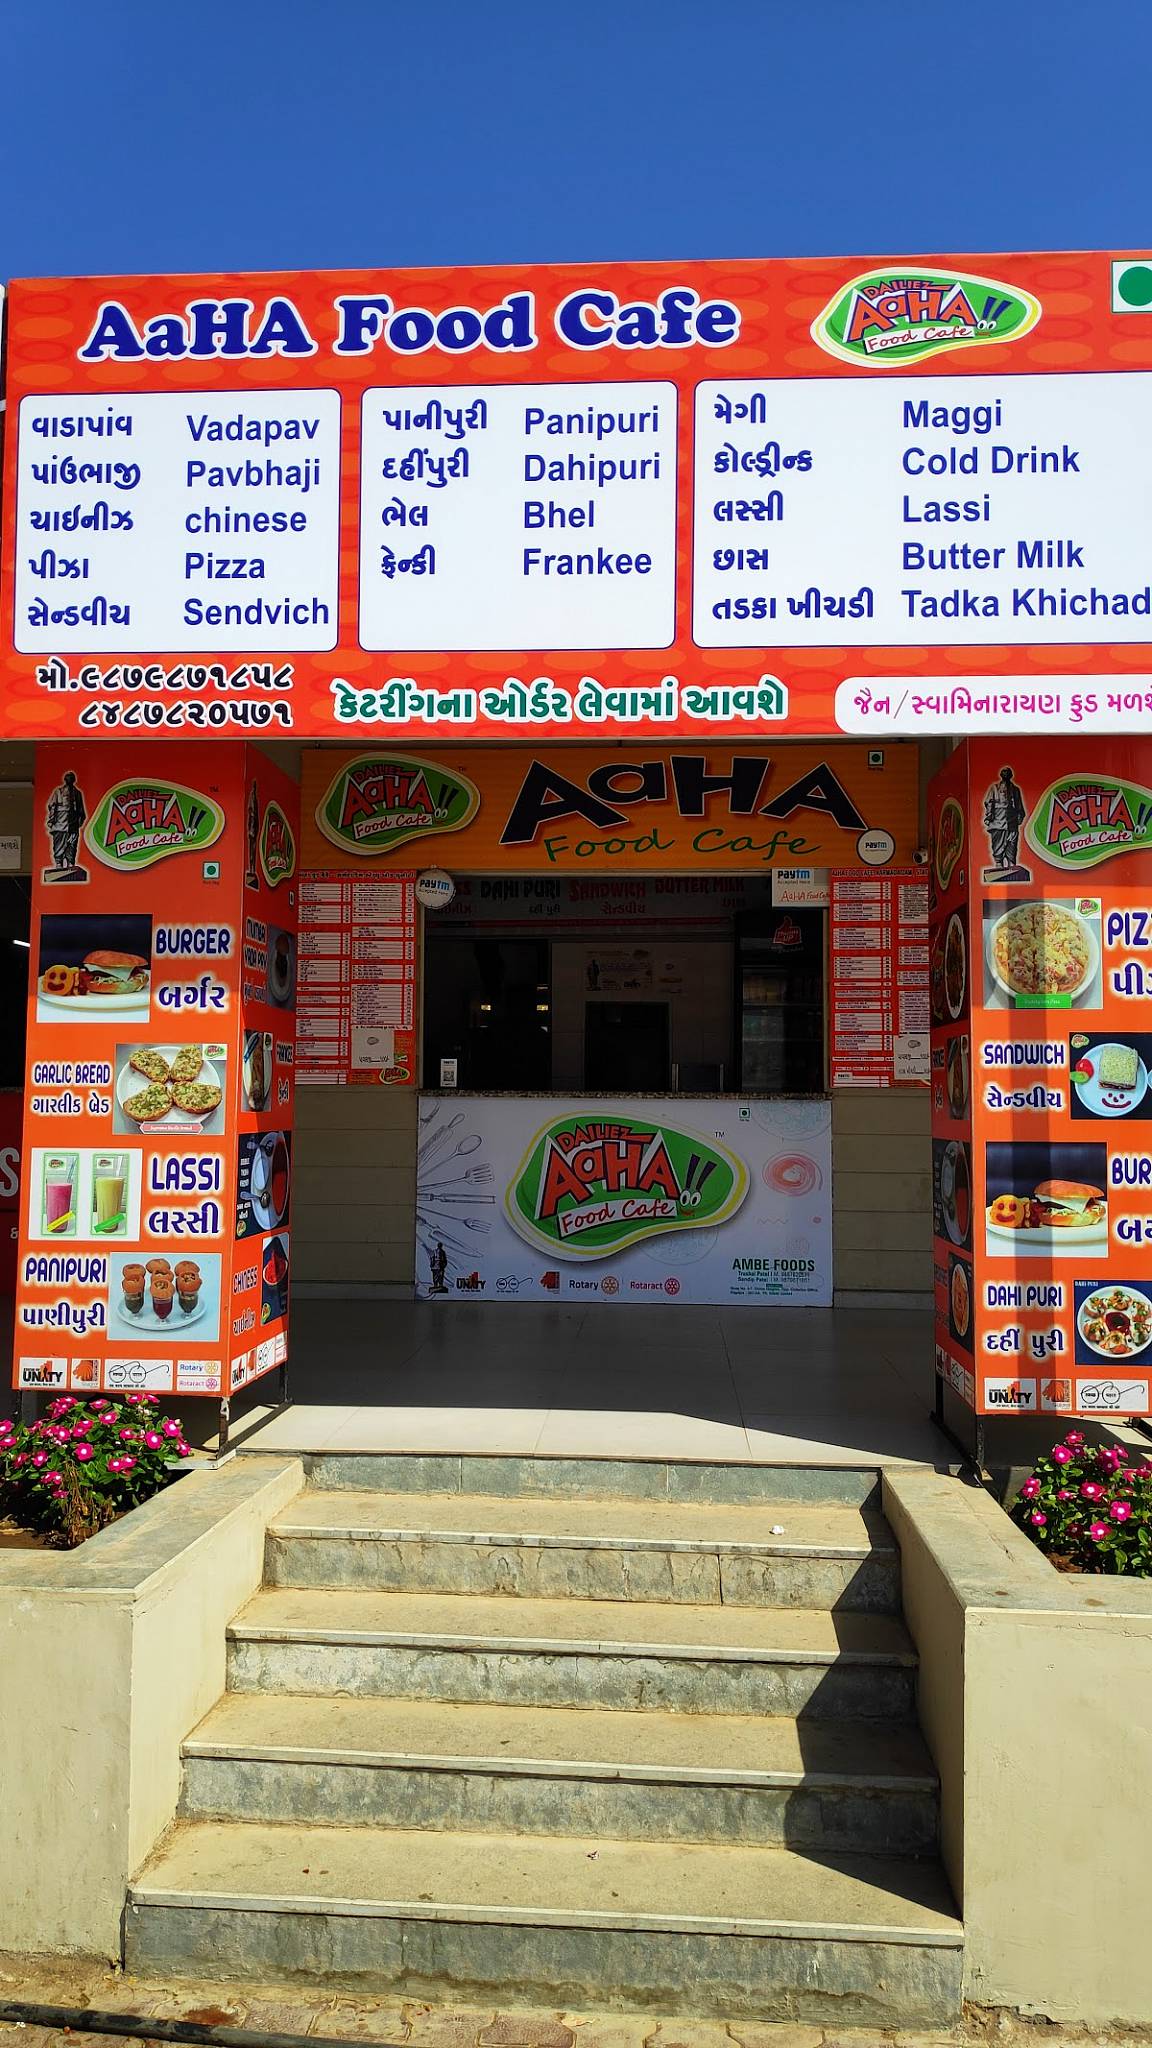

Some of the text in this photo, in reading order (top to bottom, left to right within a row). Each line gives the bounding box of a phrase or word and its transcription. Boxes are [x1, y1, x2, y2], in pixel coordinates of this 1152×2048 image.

[79, 291, 737, 358] AaHA Food Cafe
[867, 326, 973, 351] Food Cafe
[32, 407, 132, 437] વાડાપાંવ
[383, 399, 487, 440] પાનીપુરી
[525, 406, 659, 440] Panipuri
[714, 393, 766, 424] મેગી
[903, 399, 1001, 434] Maggi
[187, 414, 320, 447] Vadapav
[32, 455, 141, 490] પાંઉભાજી
[383, 447, 469, 488] દહીંપુરી
[524, 452, 660, 487] Dahipuri
[902, 445, 1080, 475] Cold Drink
[187, 459, 320, 492] Pavbhaji
[185, 506, 307, 533] chinese
[382, 496, 428, 526] ભેલ
[524, 500, 595, 528] Bhel
[713, 490, 783, 521] લસ્સી
[903, 494, 990, 523] Lassi
[29, 549, 89, 579] પીઝા
[185, 552, 265, 579] Pizza
[523, 547, 652, 575] Frankee
[713, 549, 769, 570] છાસ
[903, 540, 1085, 570] Butter Milk
[28, 595, 131, 626] સેન્ડવીચ
[183, 598, 329, 625] Sendvich
[712, 587, 874, 619] તડકા ખીચડી
[901, 589, 1000, 618] Tadka
[81, 703, 291, 725] ૮૪૮૭૮૨૦૫૭૧
[335, 679, 784, 719] કેટરીંગના ઓર્ડર લેવામાં આવશે
[1068, 694, 1098, 722] ફુડ
[499, 755, 868, 845] AaHA
[356, 814, 430, 836] Food Cafe
[118, 834, 182, 854] Food Cafe
[544, 828, 822, 862] Food Cafe
[1061, 831, 1131, 852] Food Cafe
[156, 928, 230, 954] BURGER
[1107, 912, 1152, 946] PIZ
[159, 976, 225, 1008] બર્ગર
[1114, 962, 1152, 995] પી
[984, 1044, 1064, 1065] SANDWICH
[34, 1064, 110, 1084] GARLIC BREAD
[33, 1093, 81, 1113] ગારલીક
[987, 1086, 1062, 1109] સેન્ડવીચ
[556, 1123, 654, 1153] DAILIEZ
[152, 1157, 220, 1191] LASSI
[149, 1201, 219, 1234] લસ્સી
[562, 1199, 675, 1233] Food Cafe
[26, 1257, 106, 1283] PANIPURI
[732, 1258, 815, 1271] AMBE FOODS
[569, 1279, 598, 1291] Rotary
[630, 1281, 663, 1290] Rotaract
[988, 1285, 1062, 1306] DAHI PURI
[23, 1302, 105, 1334] પાણીપુરી
[1032, 1328, 1064, 1357] પુરી
[180, 1363, 203, 1372] Rotary
